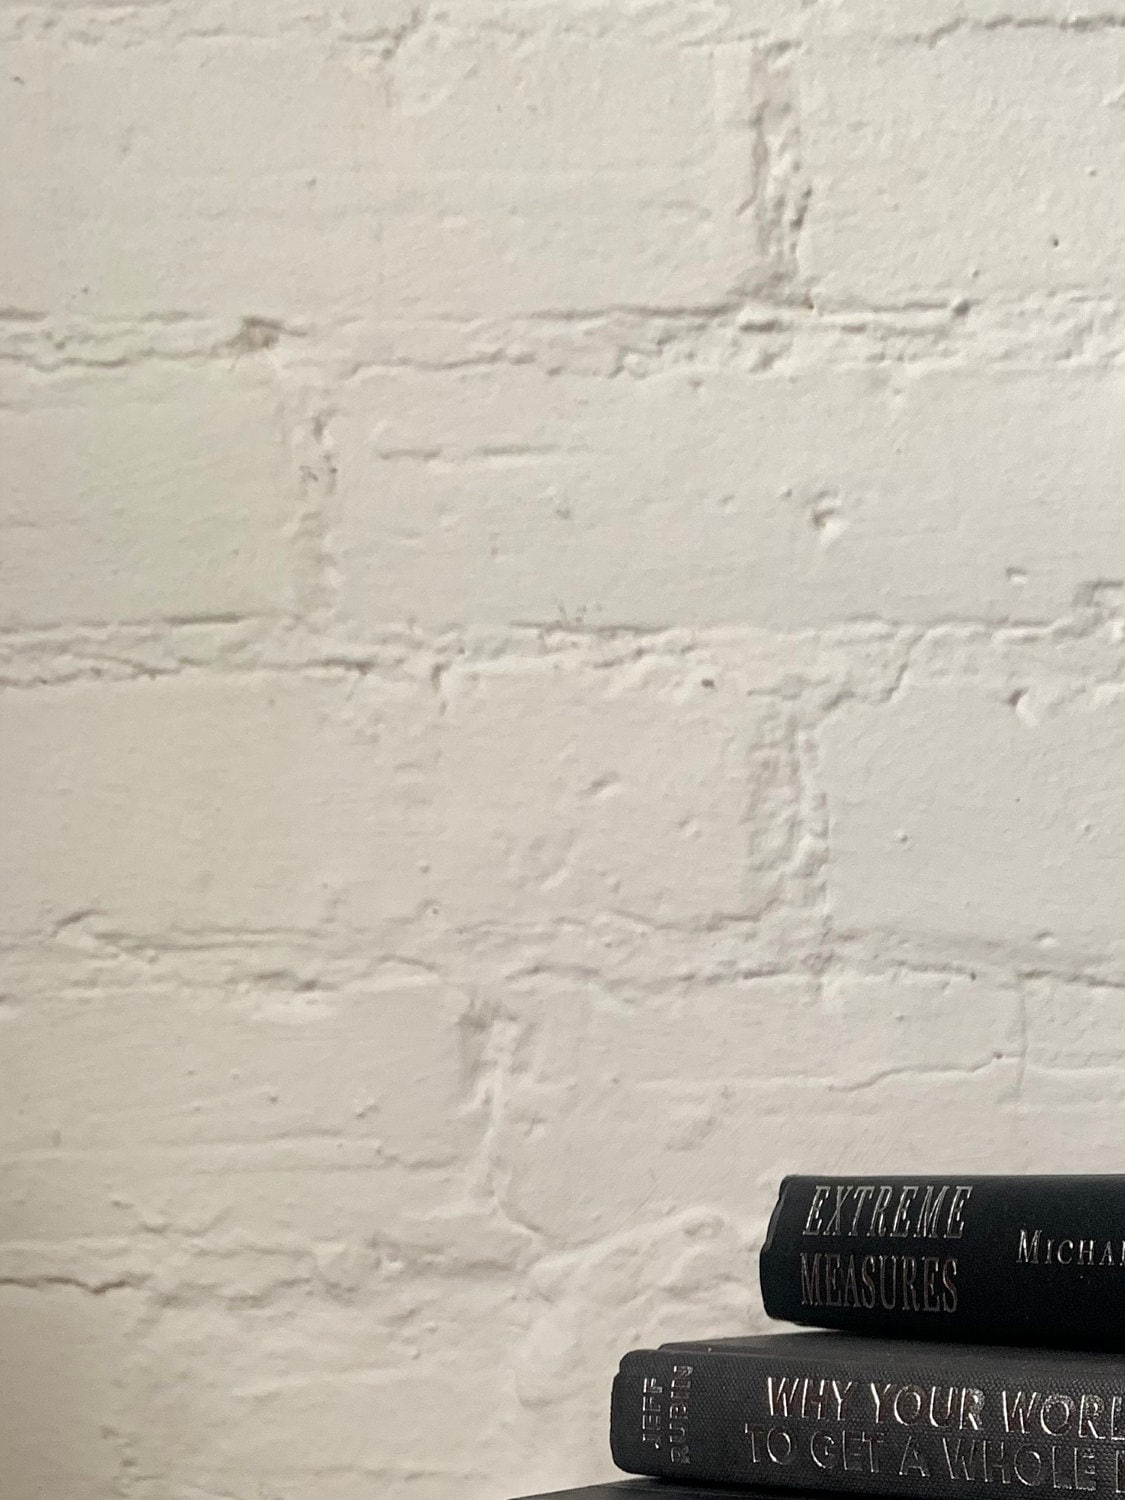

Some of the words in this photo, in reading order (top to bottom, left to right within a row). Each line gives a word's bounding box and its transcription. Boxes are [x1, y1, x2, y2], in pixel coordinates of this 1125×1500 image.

[802, 1185, 972, 1239] EXTREME
[800, 1253, 959, 1313] MEASURES
[642, 1378, 662, 1449] JEFF
[669, 1366, 694, 1464] RUBIN
[767, 1376, 855, 1422] WHY
[870, 1383, 985, 1431] YOUR
[744, 1423, 793, 1465] TO
[810, 1429, 885, 1473] GET
[899, 1436, 930, 1477] A
[942, 1437, 1097, 1491] WHOLE
